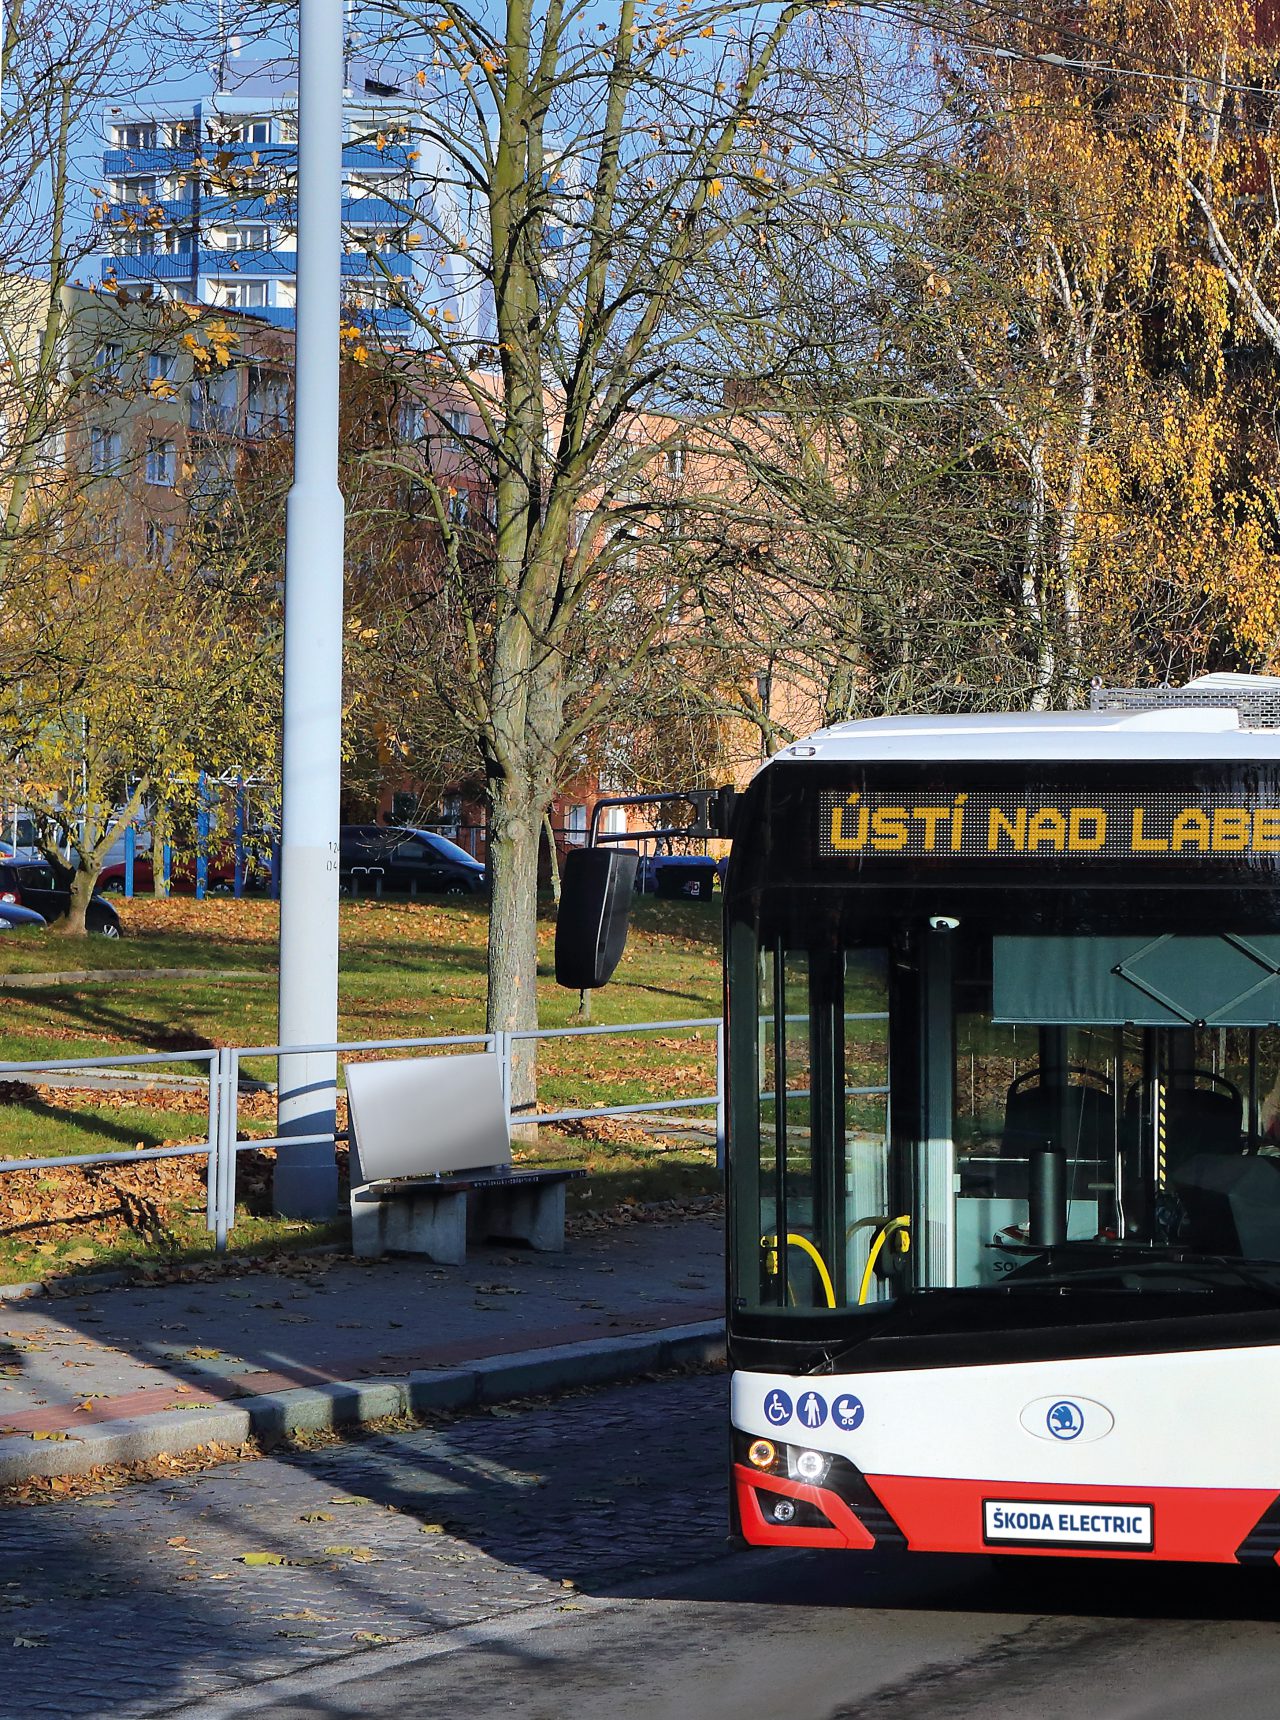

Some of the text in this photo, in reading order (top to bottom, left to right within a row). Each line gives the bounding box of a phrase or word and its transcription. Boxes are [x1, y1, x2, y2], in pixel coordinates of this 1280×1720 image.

[831, 793, 967, 850] ÚSTÍ
[988, 807, 1106, 850] NAD
[993, 1508, 1142, 1533] ŠKODA ELECTRIC
